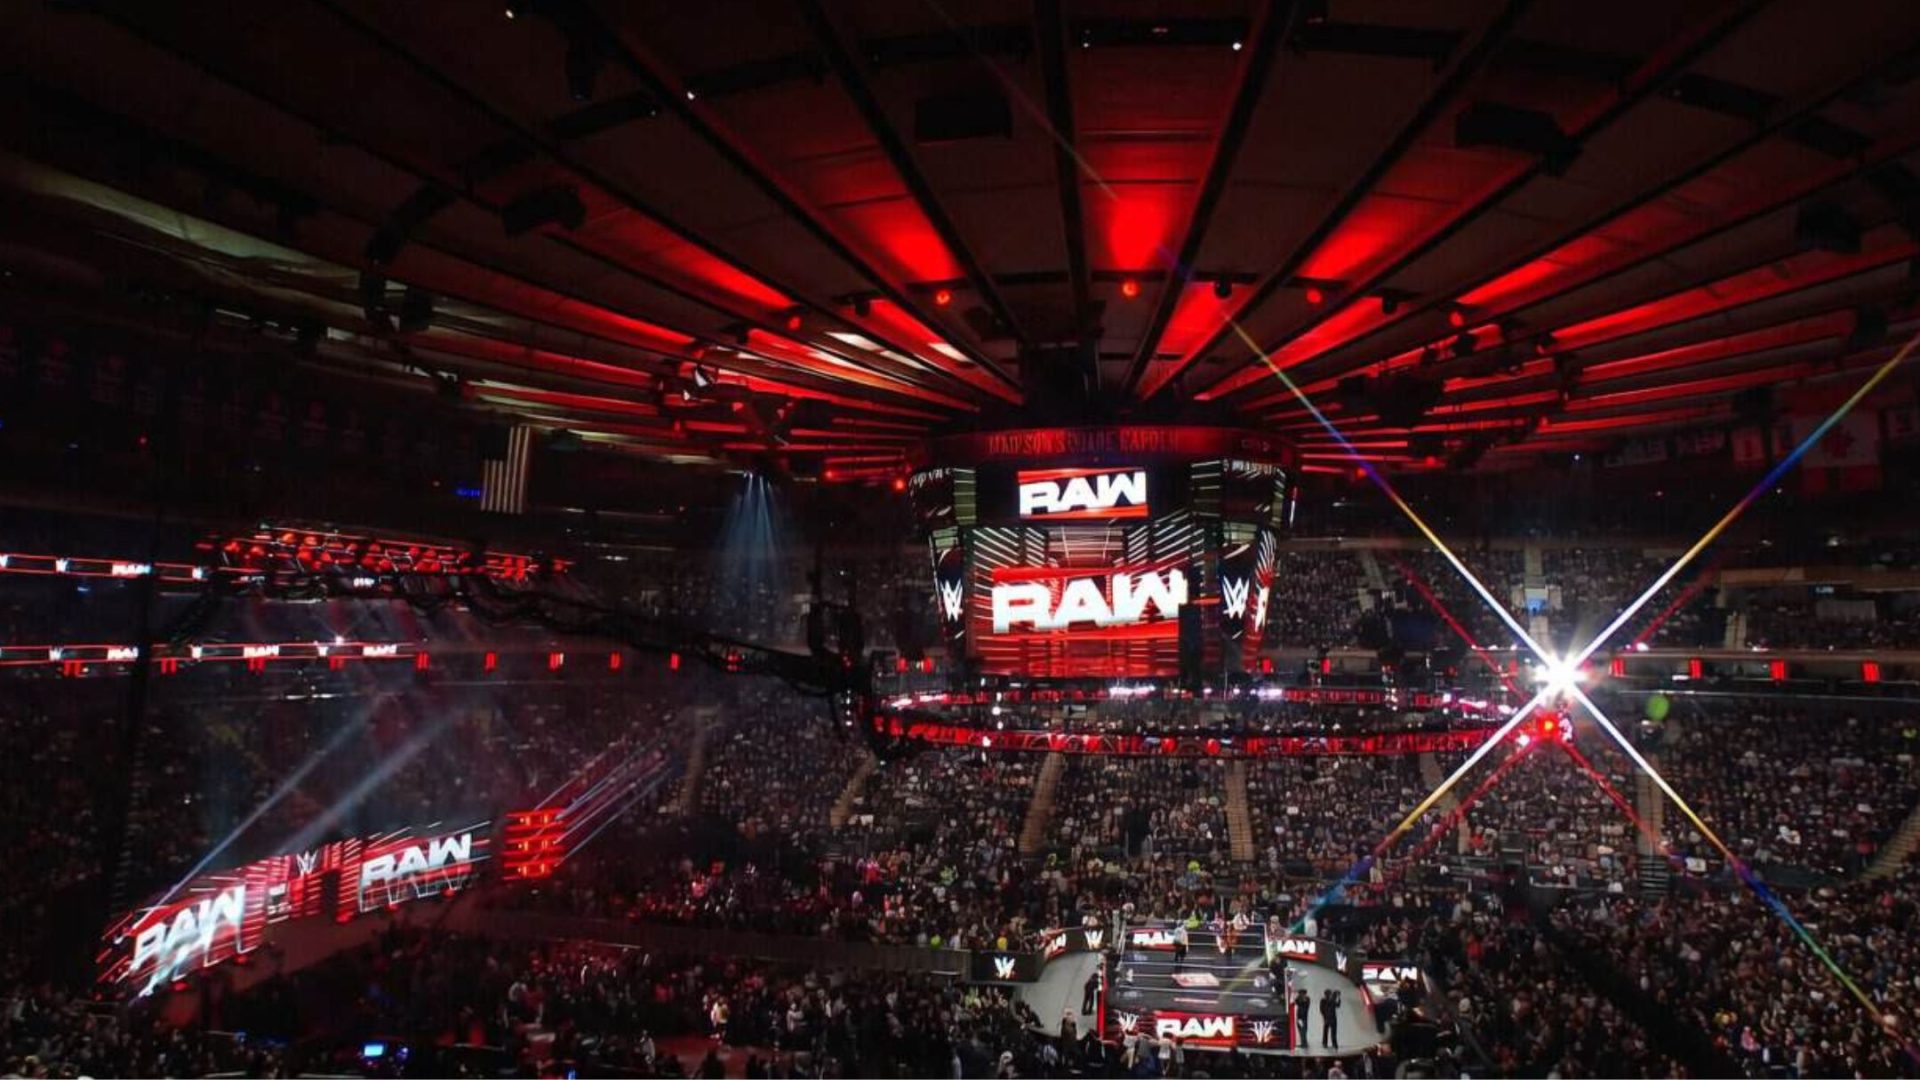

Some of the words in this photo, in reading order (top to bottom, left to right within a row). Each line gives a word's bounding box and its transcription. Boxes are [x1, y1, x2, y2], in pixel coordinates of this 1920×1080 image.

[1020, 471, 1146, 515] RAW
[992, 568, 1188, 634] RAW
[361, 833, 472, 888] RAW
[130, 884, 246, 972] RAW
[1156, 1016, 1234, 1038] RAW
